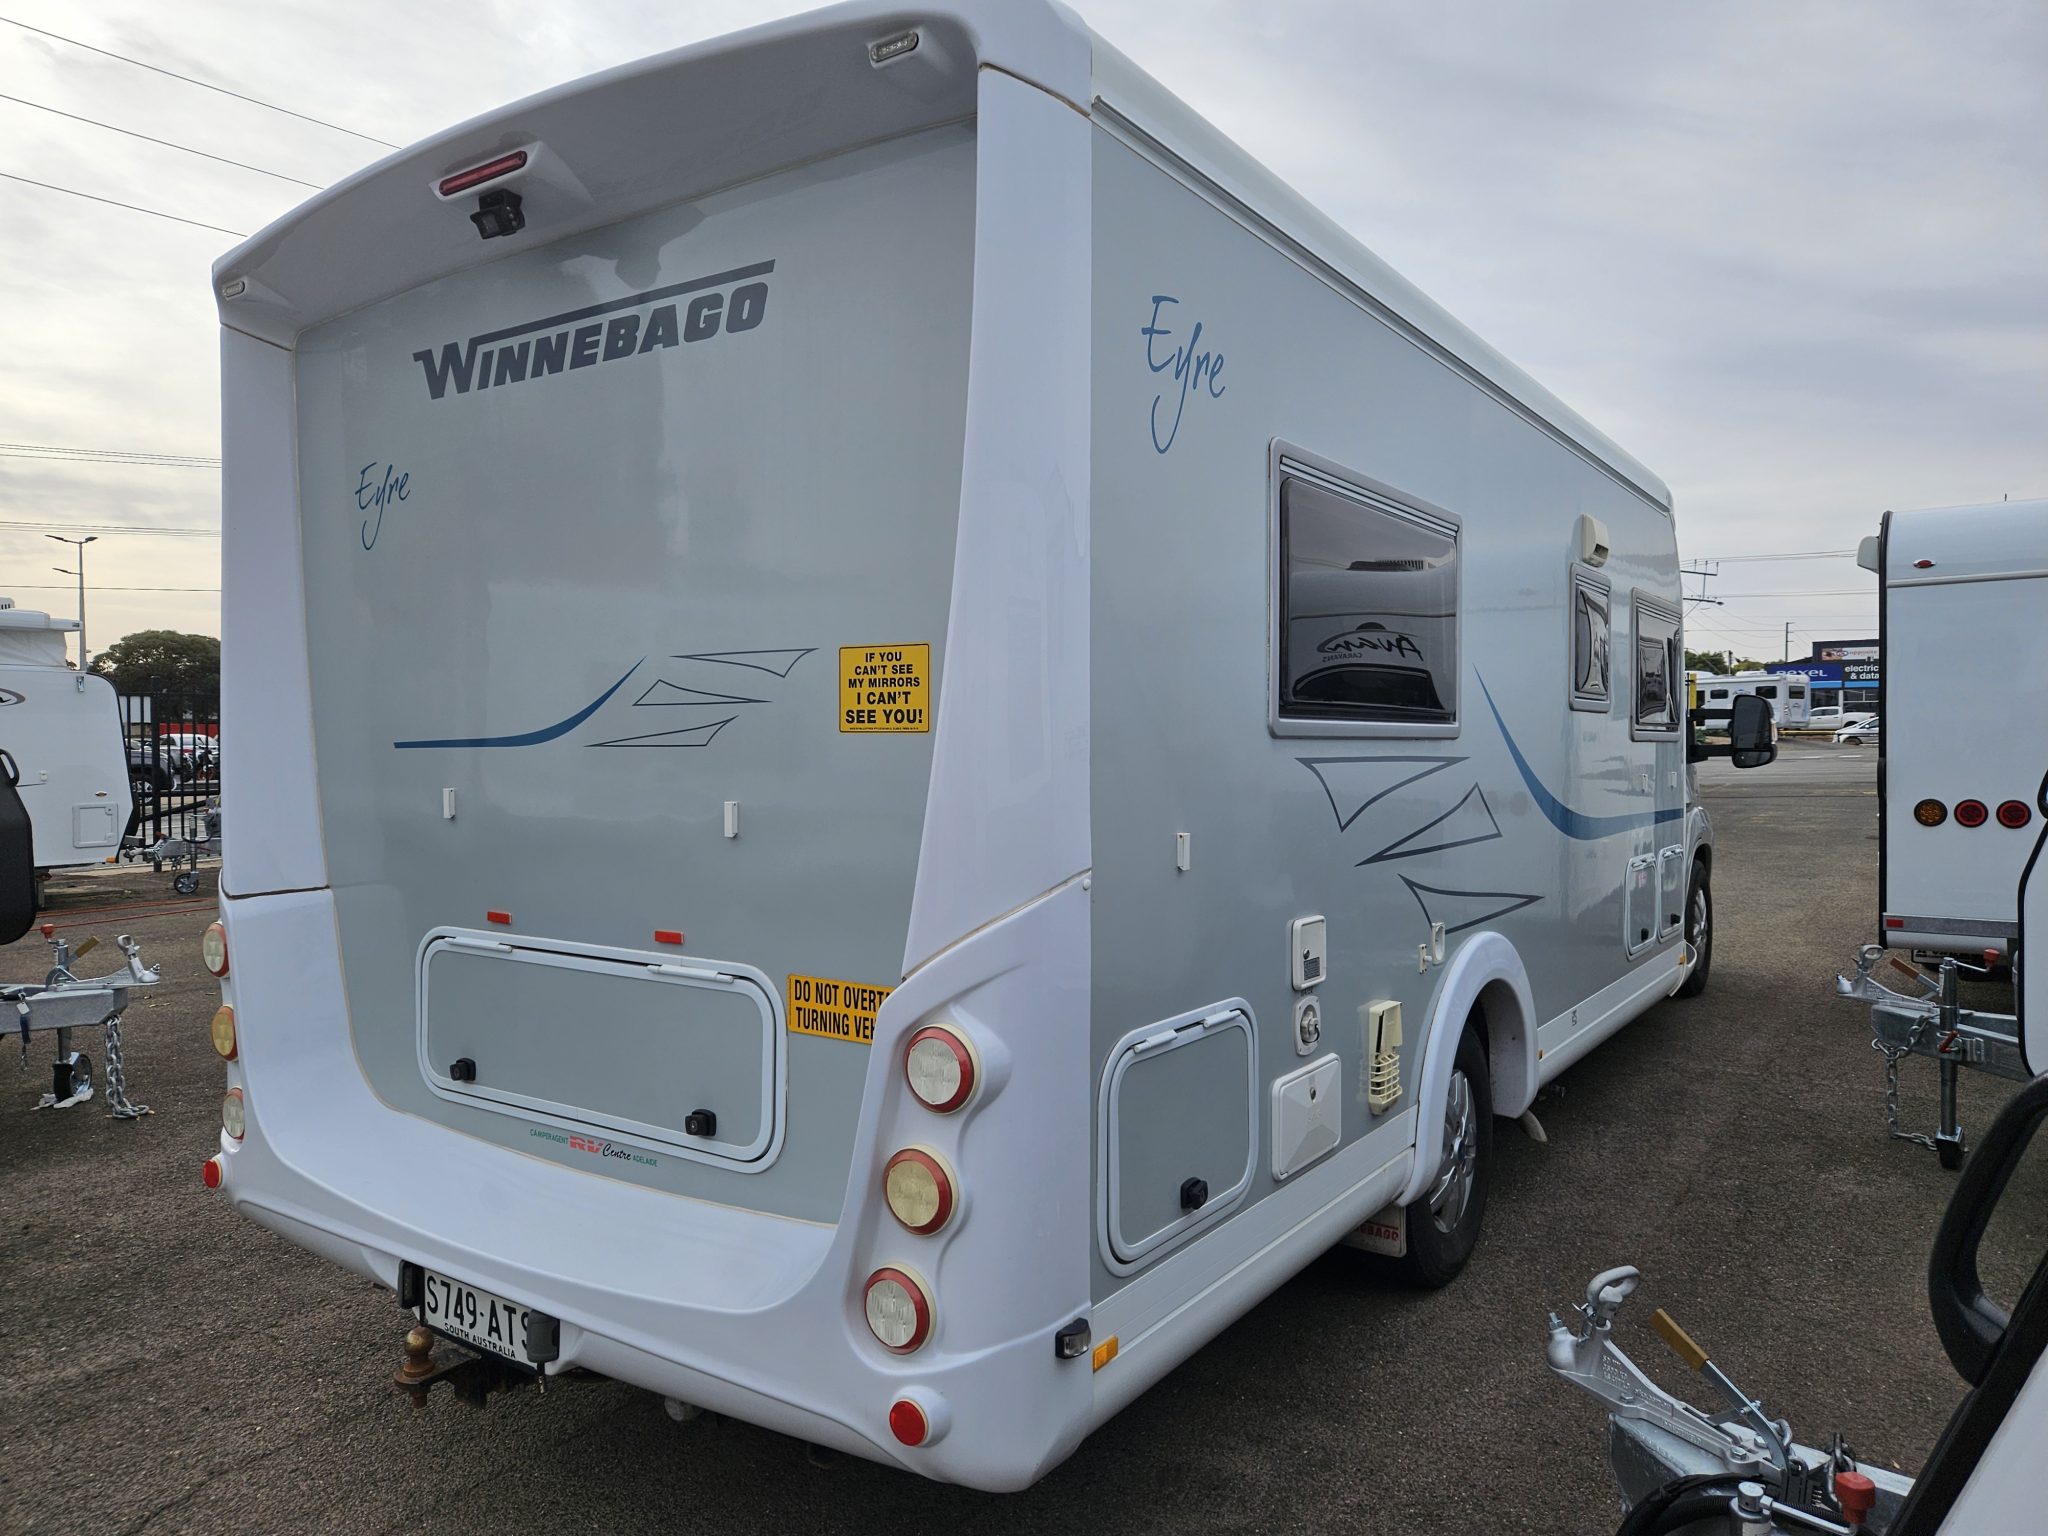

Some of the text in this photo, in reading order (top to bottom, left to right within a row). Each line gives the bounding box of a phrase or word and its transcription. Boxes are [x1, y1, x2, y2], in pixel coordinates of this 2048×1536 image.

[1141, 295, 1226, 454] Eyre
[355, 461, 411, 551] Eyre
[865, 651, 902, 663] IF YOU
[854, 664, 913, 676] CAN'T SEE
[1850, 671, 1879, 680] & data
[848, 676, 920, 689] MY MIRRORS
[857, 691, 911, 705] I CAN'T
[845, 708, 923, 724] SEE YOU!
[794, 979, 811, 1003] DO
[815, 982, 839, 1007] NOT
[795, 1006, 850, 1036] TURNING
[569, 1135, 604, 1154] RV
[602, 1143, 632, 1161] Centre
[444, 1322, 516, 1360] SOUTH AUSTRALIA
